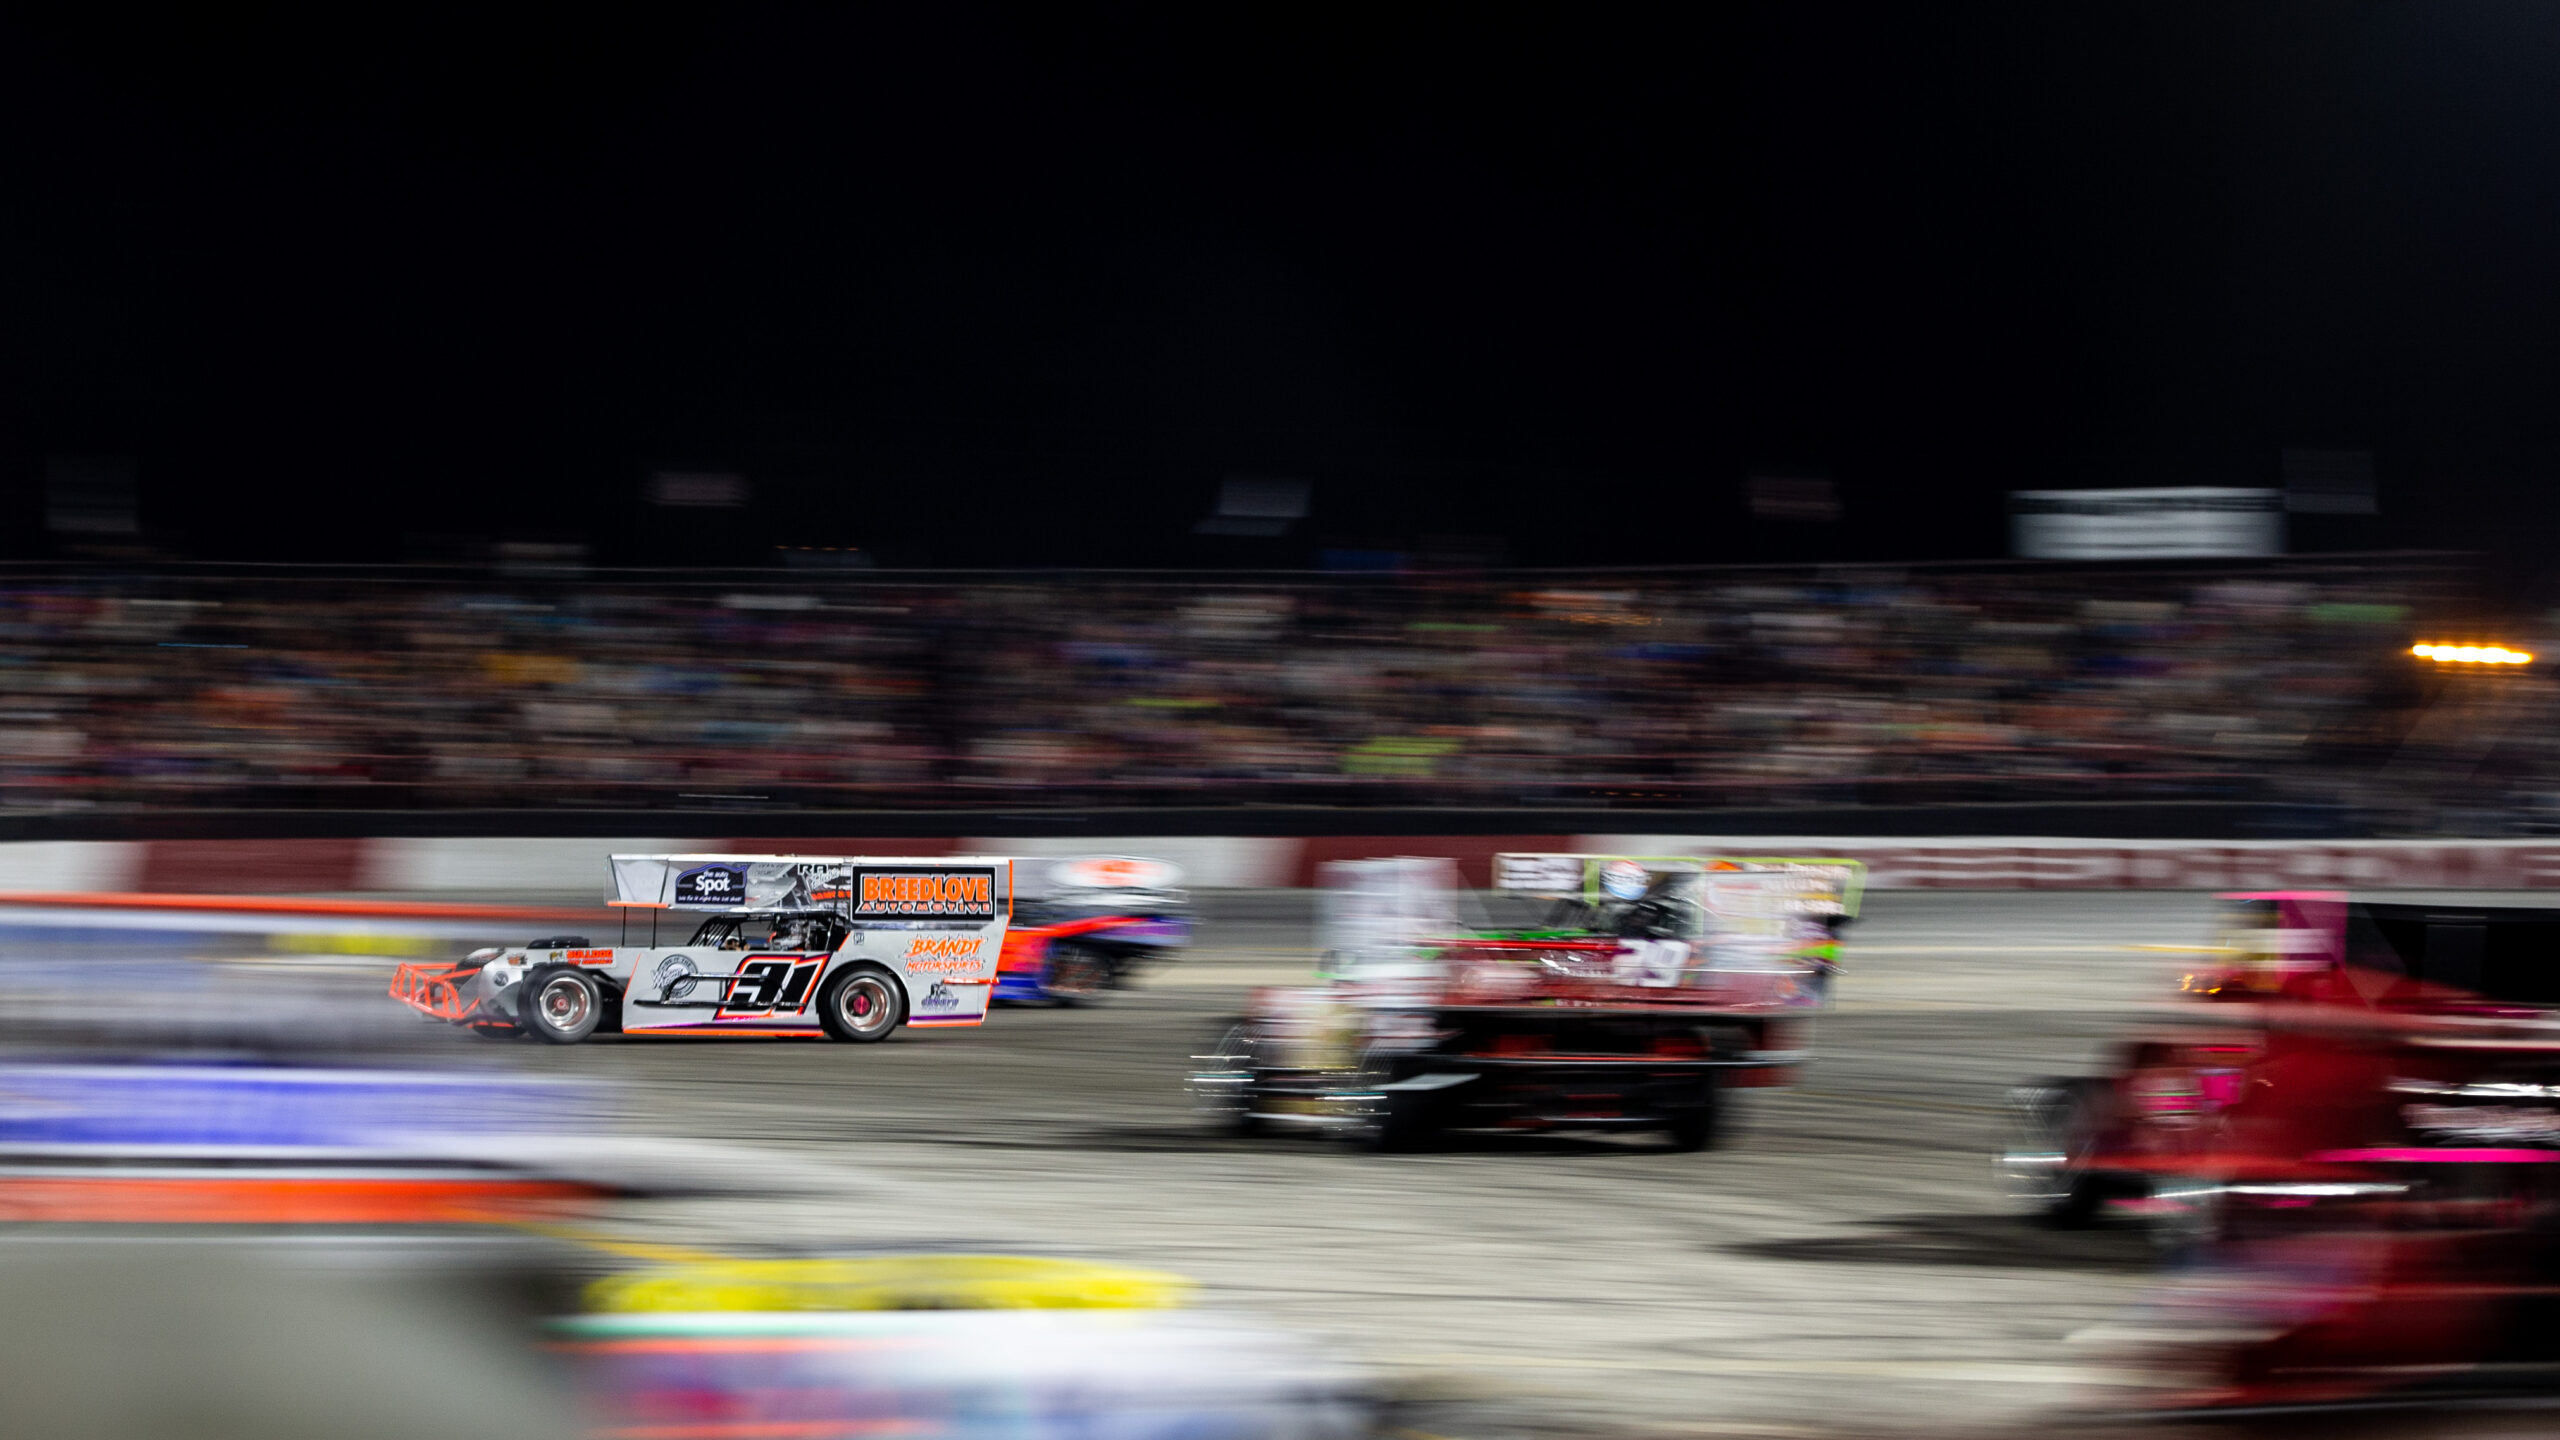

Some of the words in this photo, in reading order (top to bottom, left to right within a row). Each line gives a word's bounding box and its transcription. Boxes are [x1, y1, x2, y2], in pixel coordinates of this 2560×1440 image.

[695, 875, 731, 896] Spot
[862, 876, 990, 902] BREEDLOVE
[860, 902, 990, 913] AUTOMOTIVE
[905, 938, 985, 958] BRANDT
[905, 960, 982, 973] MOTORSPORTS
